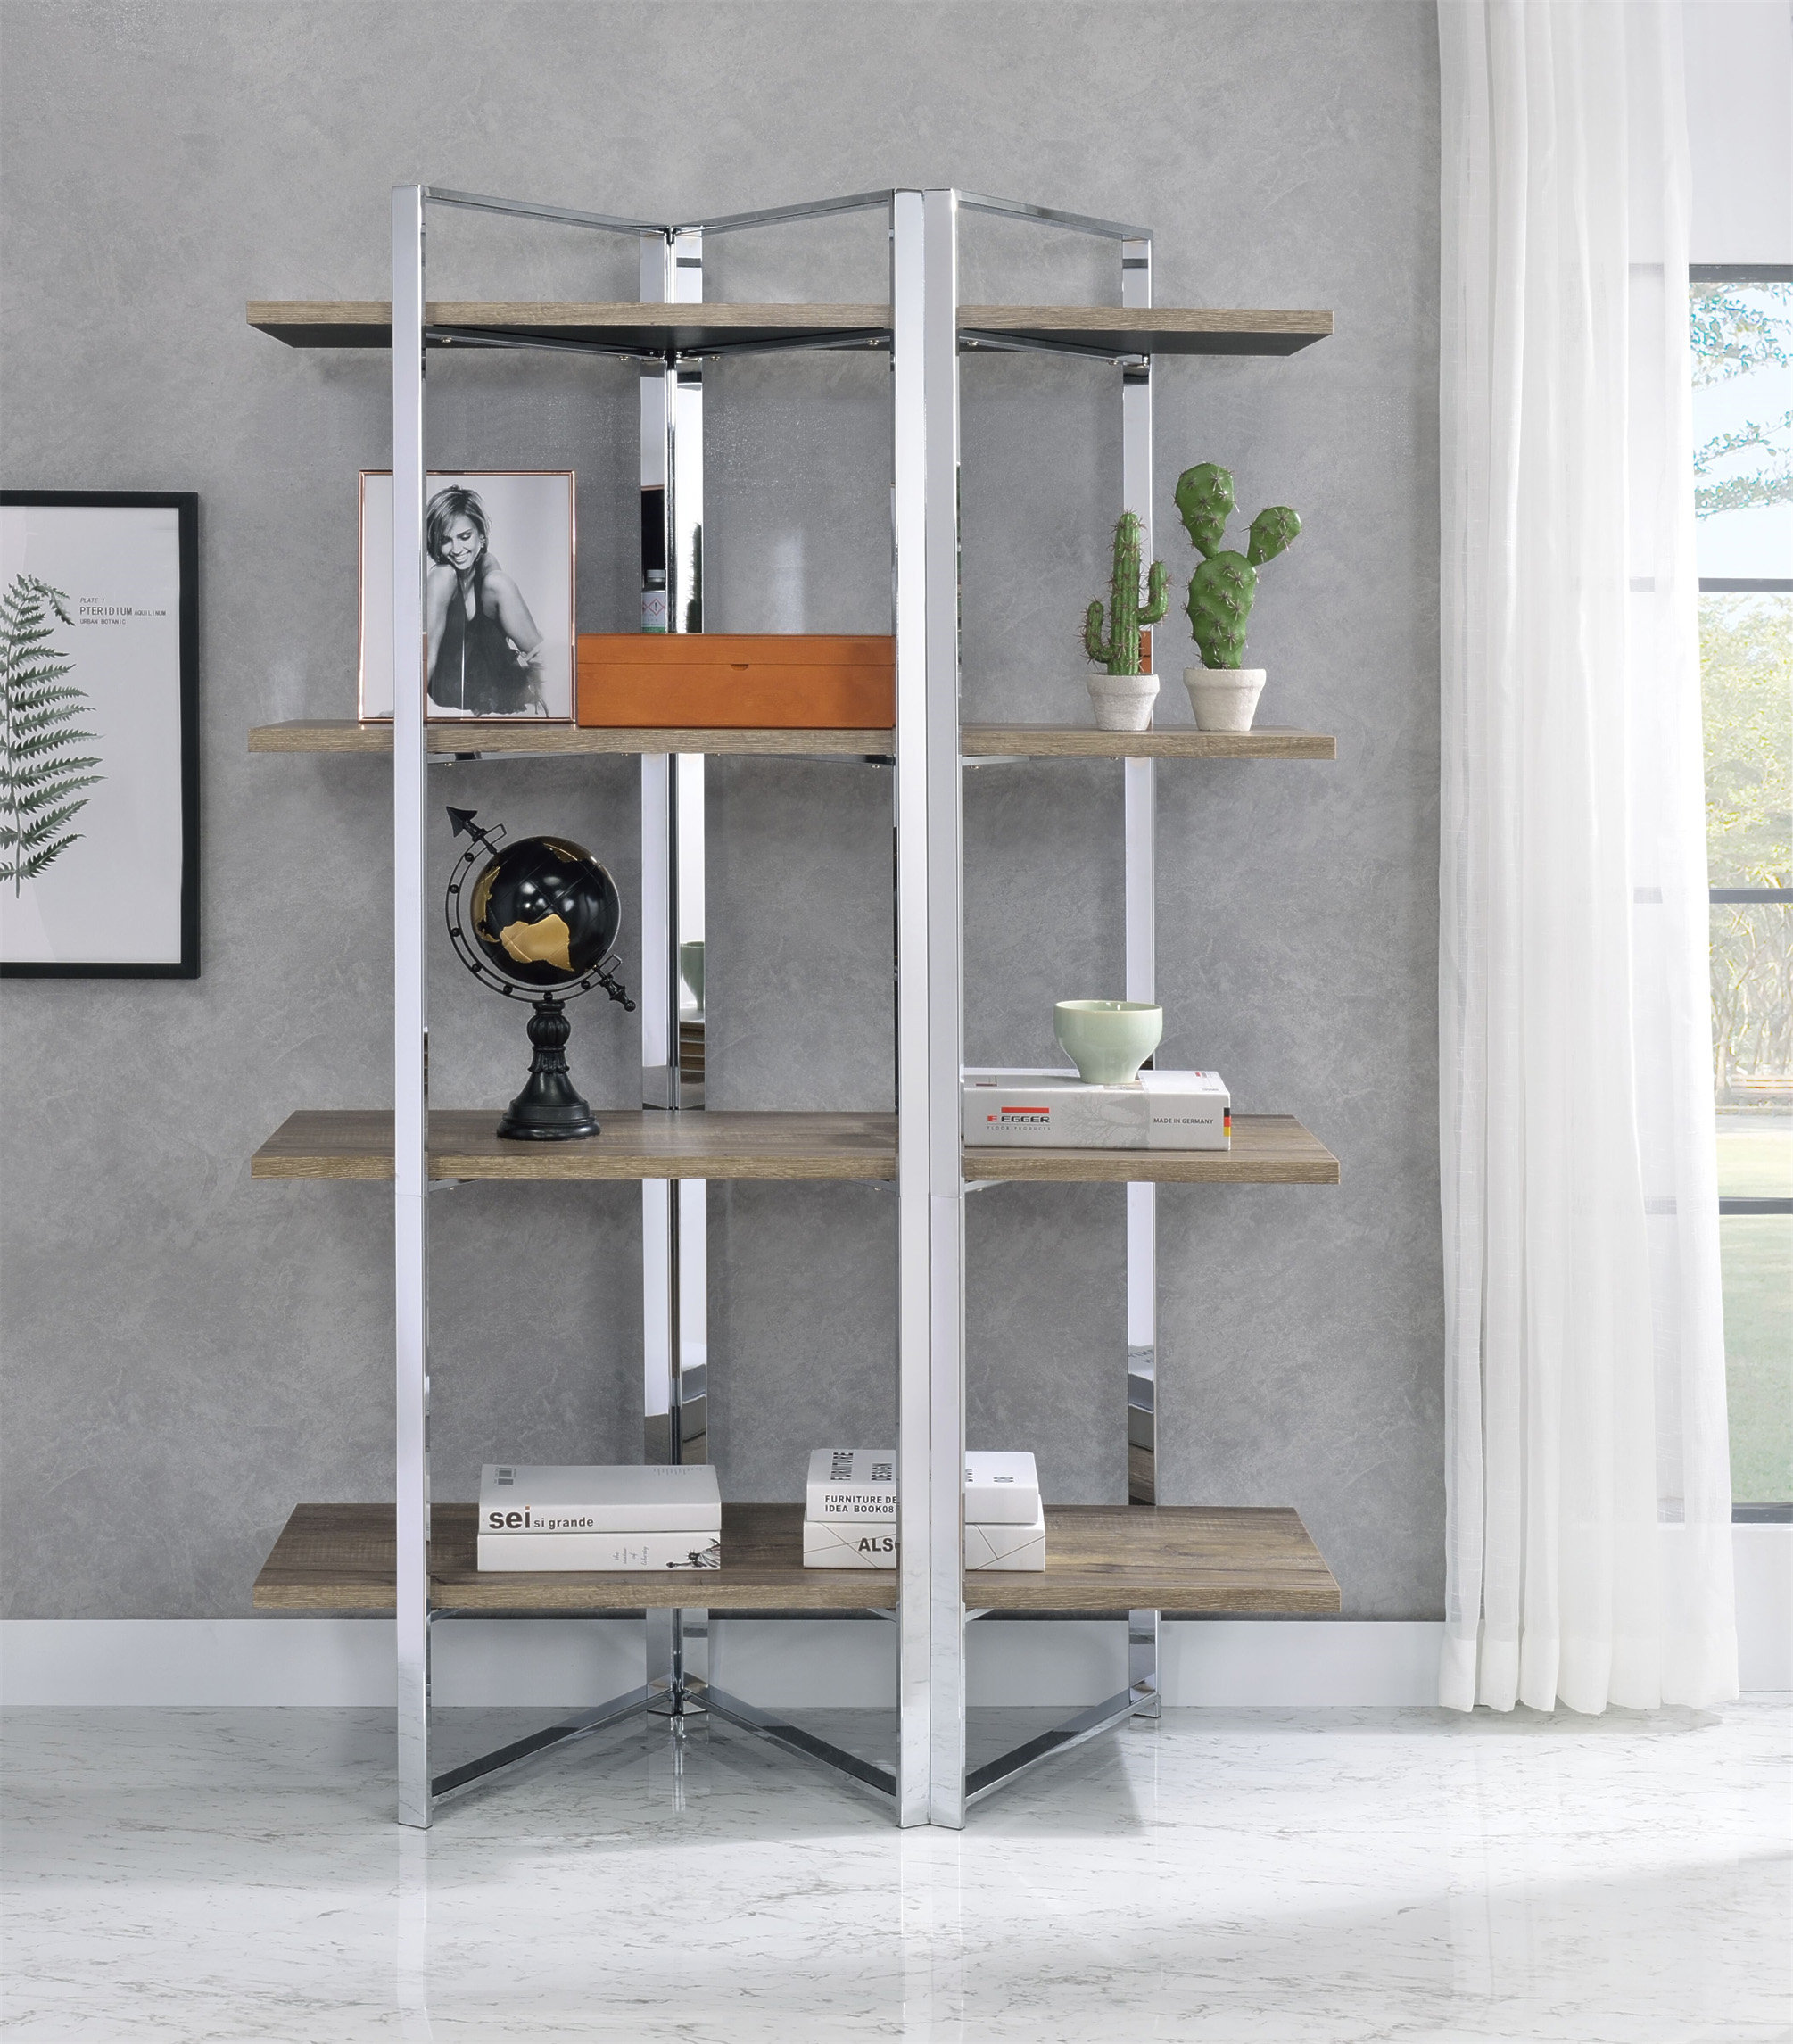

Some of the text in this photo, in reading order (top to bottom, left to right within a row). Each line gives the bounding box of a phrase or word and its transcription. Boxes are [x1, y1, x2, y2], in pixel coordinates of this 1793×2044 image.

[79, 607, 132, 616] PTERIDIUM
[1001, 1115, 1051, 1123] EGGER
[825, 1495, 882, 1503] FURNITURE
[854, 1505, 894, 1513] BOOK08
[489, 1506, 594, 1530] sei si grande
